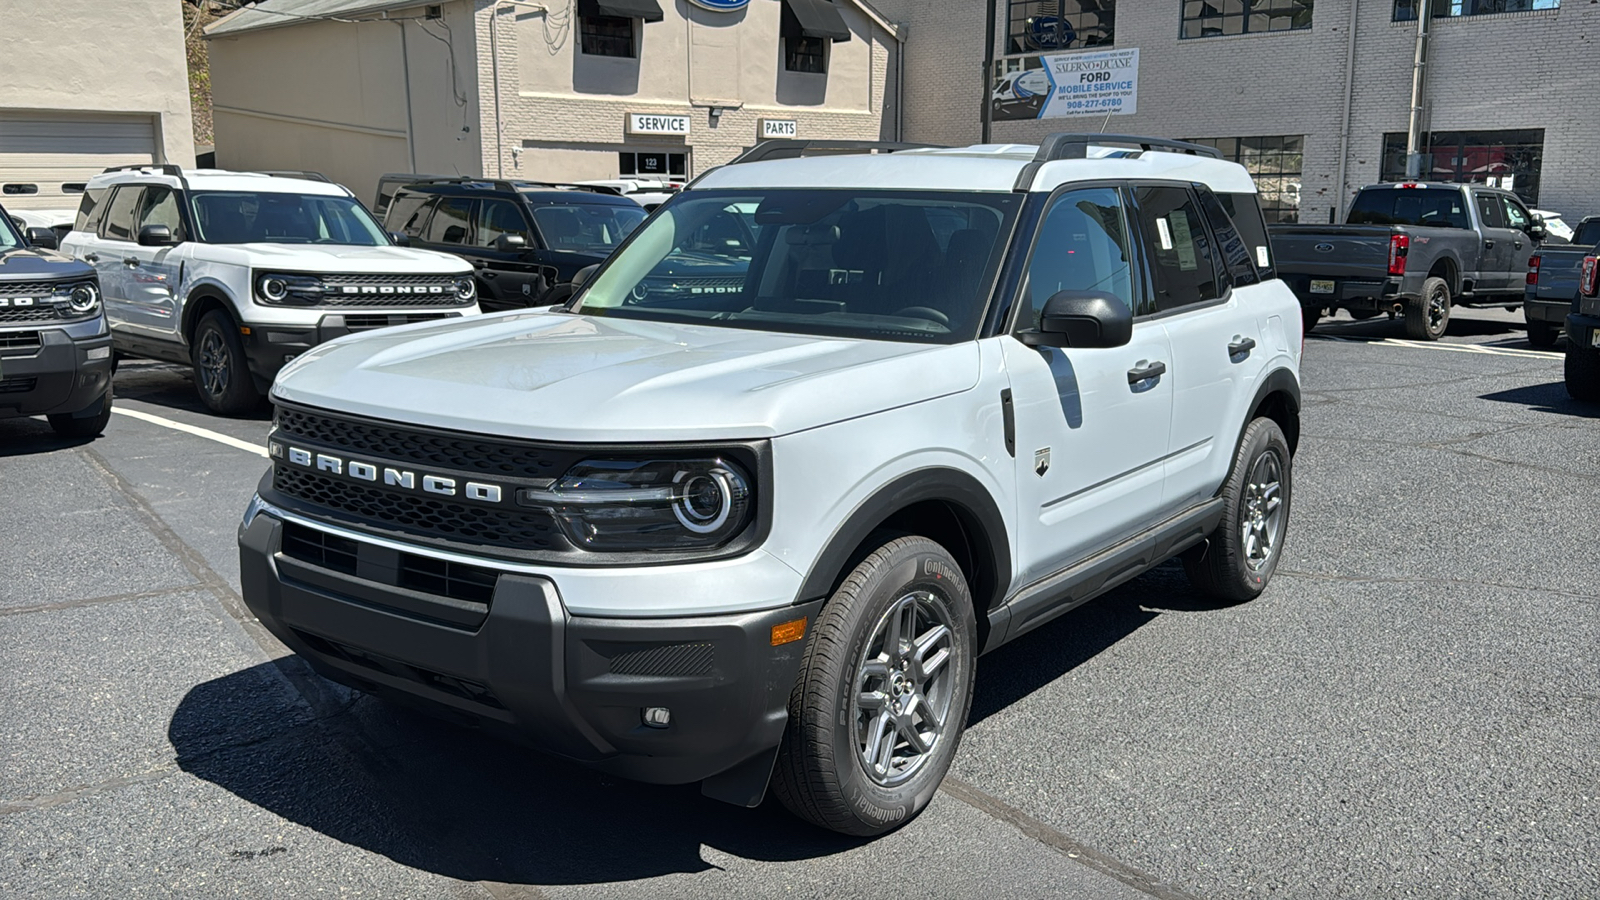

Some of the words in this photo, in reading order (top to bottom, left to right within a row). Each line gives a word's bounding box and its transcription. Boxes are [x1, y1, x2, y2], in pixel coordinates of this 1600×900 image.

[1055, 62, 1096, 73] SALERNO
[1099, 58, 1133, 69] DUANE
[1080, 71, 1111, 83] FORD
[1058, 84, 1093, 94] MOBILE
[1094, 81, 1133, 91] SERVICE
[1066, 98, 1122, 109] 908-277-6780
[639, 117, 685, 131] SERVICE
[765, 123, 795, 134] PARTS
[645, 158, 657, 166] 123
[342, 286, 443, 294] BRONCO
[289, 447, 502, 503] BRONCO
[924, 558, 965, 595] Continental
[854, 795, 906, 825] Continental
